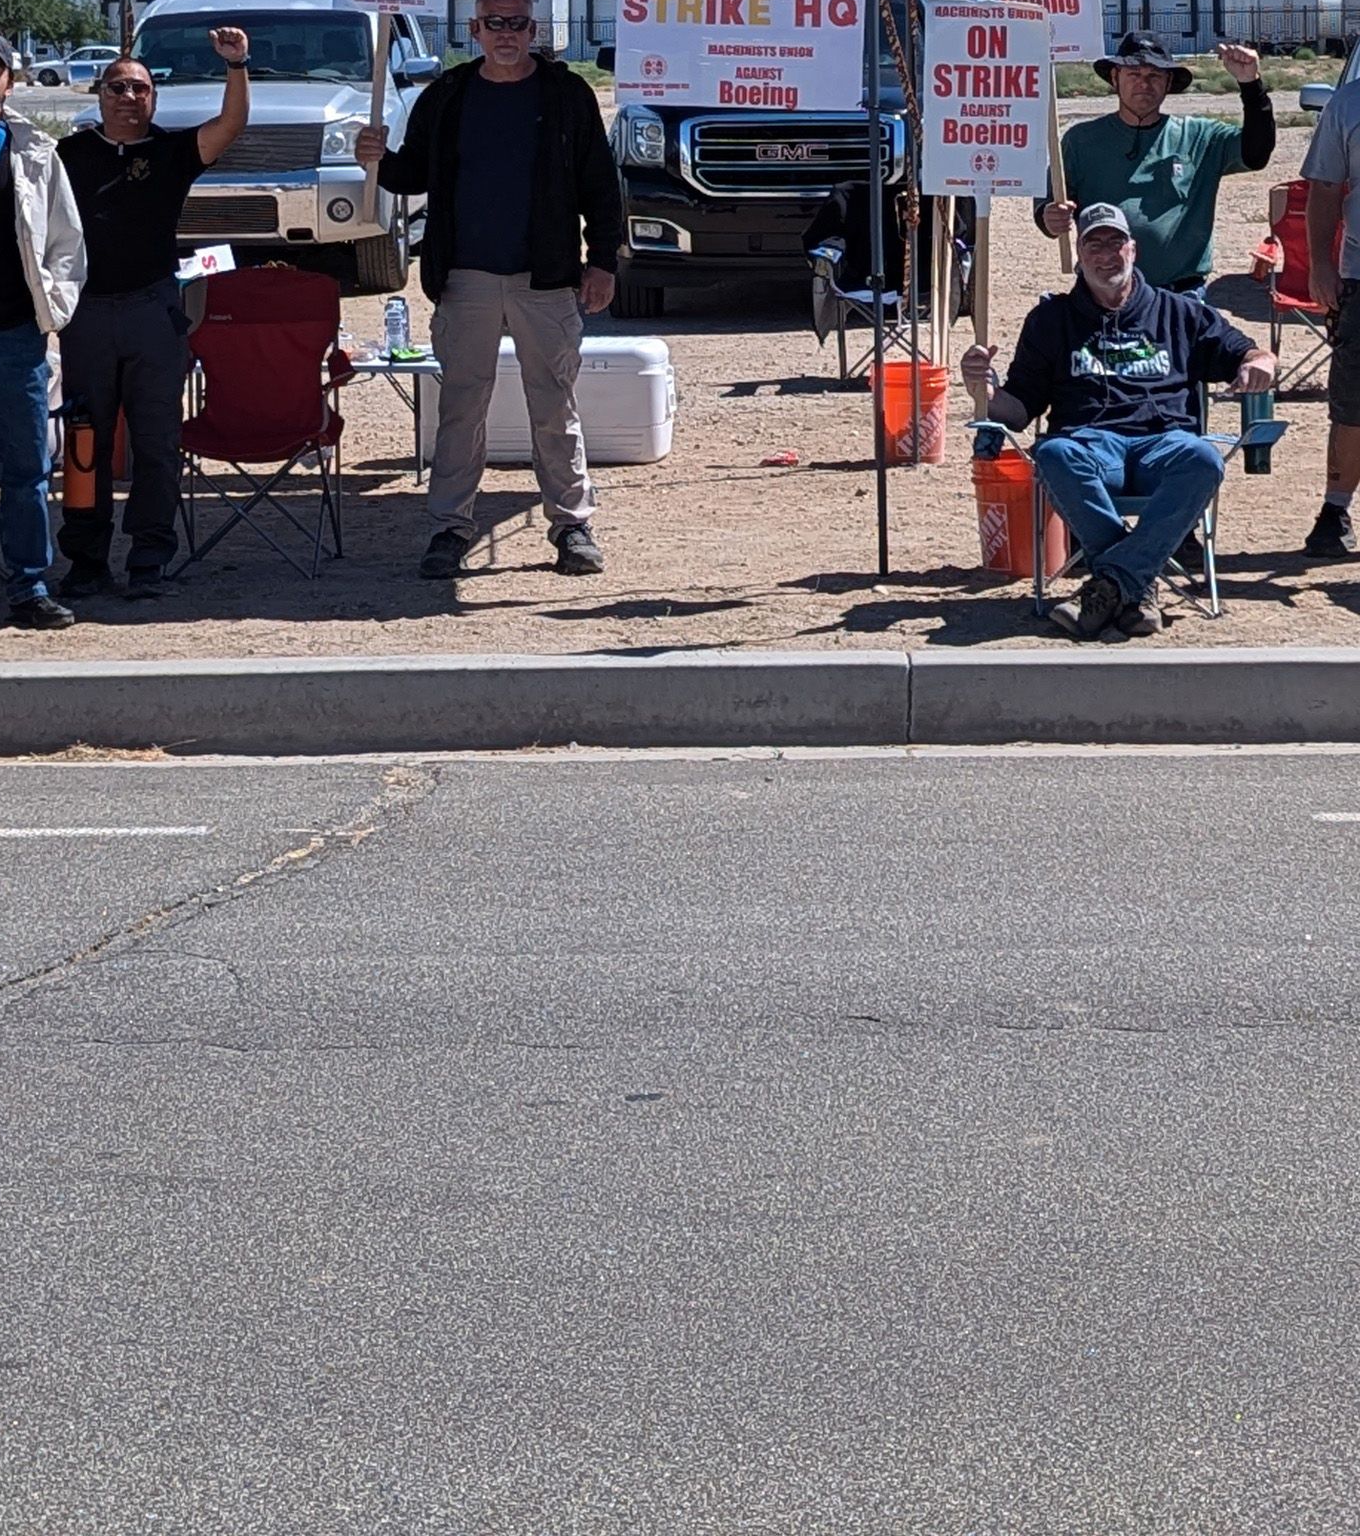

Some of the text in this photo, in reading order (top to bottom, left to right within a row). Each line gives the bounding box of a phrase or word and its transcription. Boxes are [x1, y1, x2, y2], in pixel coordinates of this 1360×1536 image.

[967, 24, 1008, 59] ON
[735, 66, 784, 81] AGAINST
[933, 64, 1040, 98] STRIKE
[719, 79, 798, 110] Boeing
[960, 103, 1012, 117] AGAINST
[943, 118, 1028, 148] Boeing
[756, 144, 829, 160] GMC
